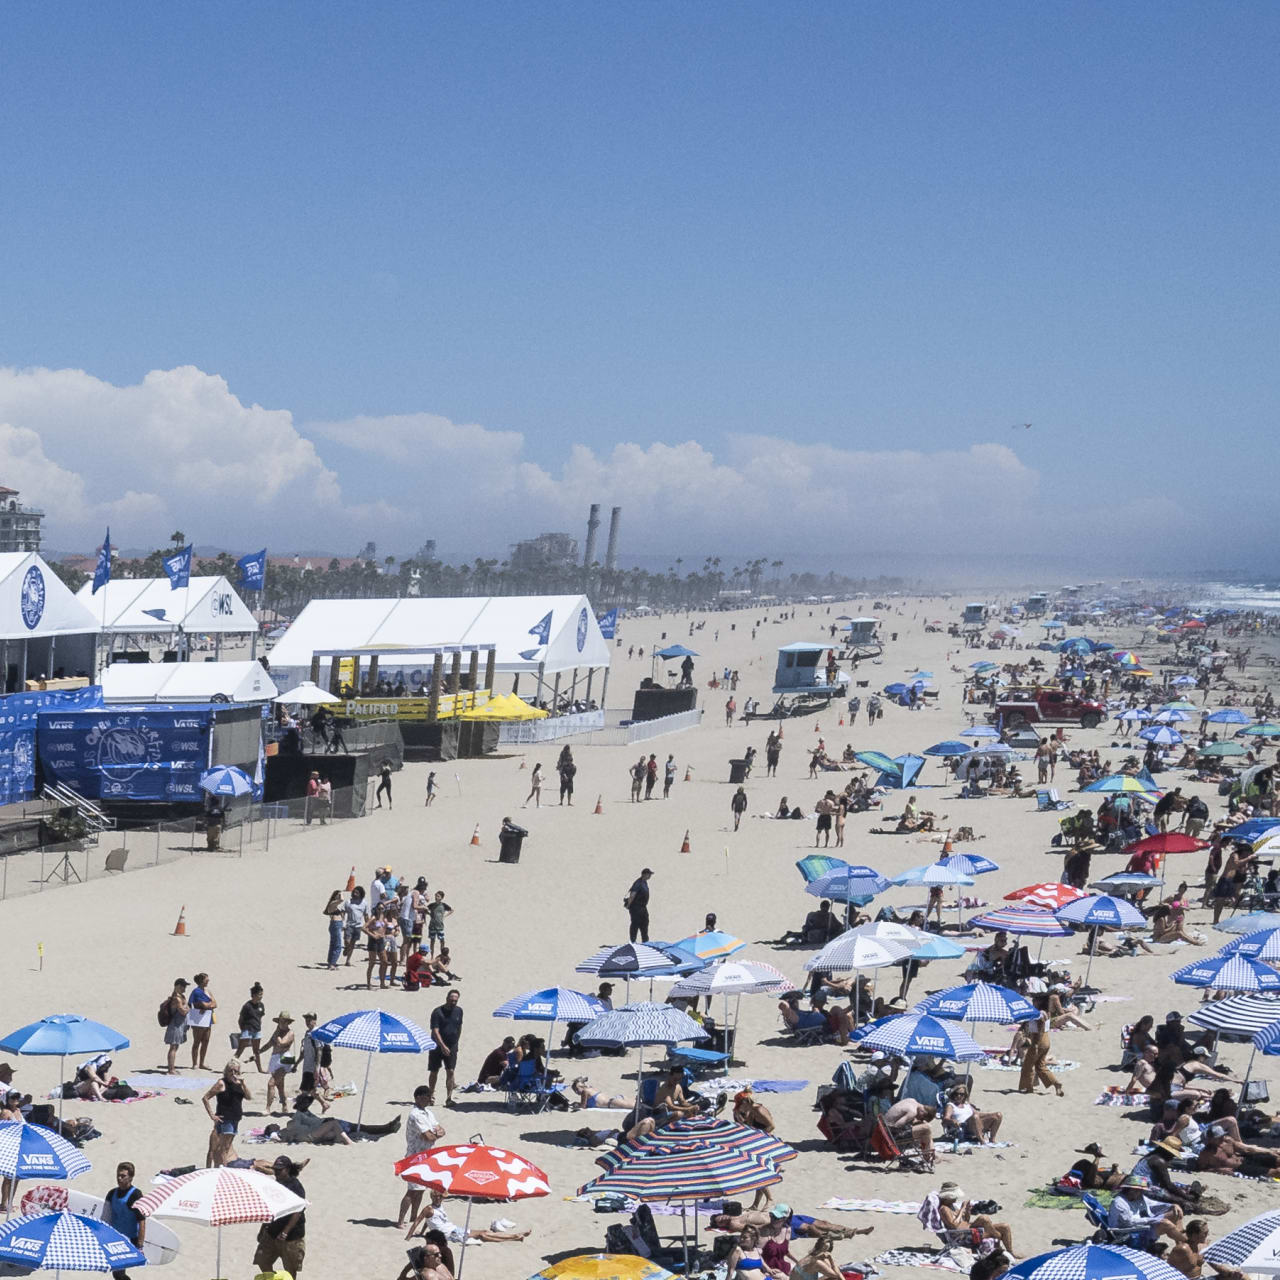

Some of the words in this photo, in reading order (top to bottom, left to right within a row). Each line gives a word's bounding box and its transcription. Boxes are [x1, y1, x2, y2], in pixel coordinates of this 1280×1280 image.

[218, 593, 233, 615] WSL
[346, 702, 399, 715] PACIFICO
[48, 720, 74, 730] VANS
[56, 743, 76, 752] WSL
[180, 742, 199, 750] WSL
[175, 784, 194, 793] WSL
[527, 1002, 554, 1011] VANS
[383, 1032, 409, 1042] VANS
[915, 1036, 945, 1047] VANS
[22, 1153, 54, 1165] VANS
[10, 1236, 45, 1250] VANS
